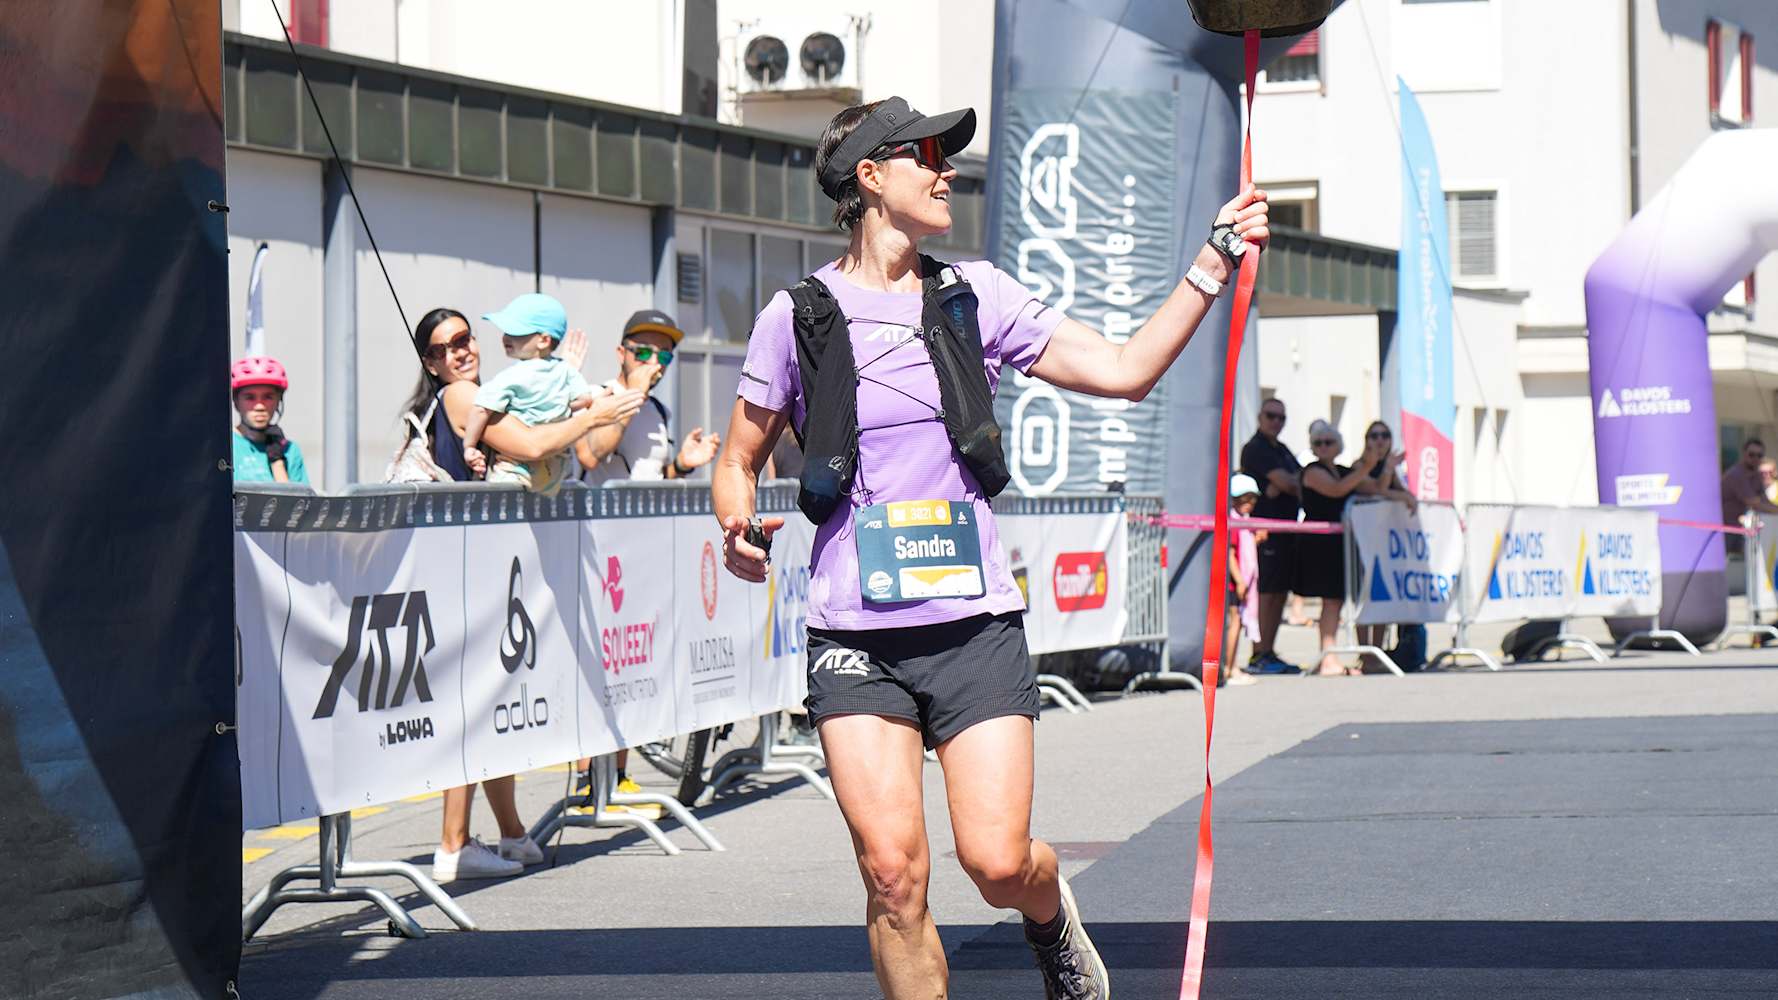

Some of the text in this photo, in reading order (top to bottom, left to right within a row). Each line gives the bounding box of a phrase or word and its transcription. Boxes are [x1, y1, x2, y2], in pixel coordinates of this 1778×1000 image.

[1621, 386, 1671, 402] DAVOS
[1621, 399, 1691, 416] KLOSTERS
[894, 533, 956, 560] Sandra
[1505, 531, 1543, 559] DAVOS
[1598, 532, 1633, 559] DAVOS
[602, 622, 656, 676] SQUEEZY
[689, 635, 736, 674] MADRISA
[494, 683, 549, 734] odlo
[386, 717, 434, 745] LOWA
